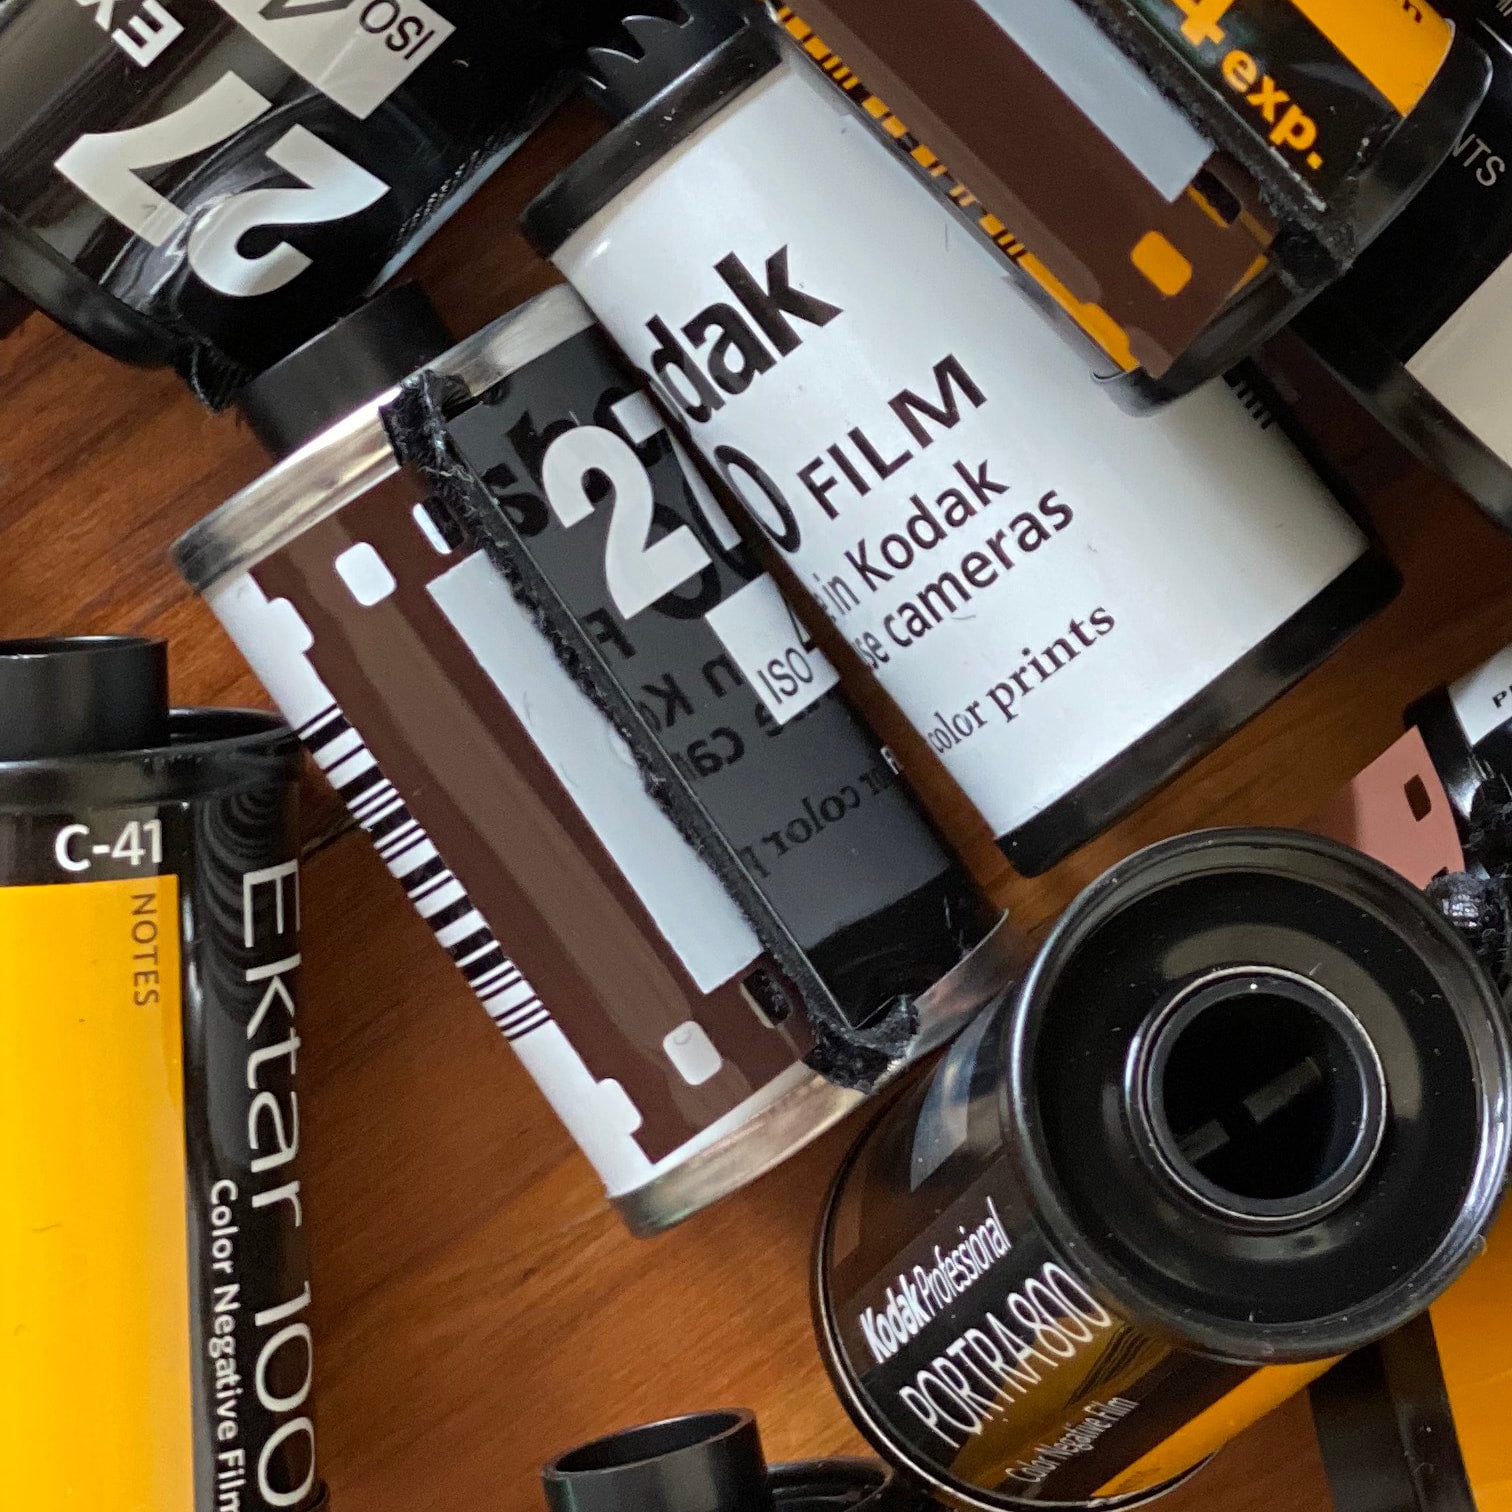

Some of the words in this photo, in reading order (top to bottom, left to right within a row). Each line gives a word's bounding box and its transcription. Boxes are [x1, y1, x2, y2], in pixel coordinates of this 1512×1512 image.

[54, 68, 389, 298] 27
[1221, 49, 1324, 170] exp.
[644, 243, 845, 423] dak
[795, 352, 989, 520] FILM
[845, 454, 1011, 595] Kodak
[889, 485, 1075, 648] cameras
[757, 643, 814, 707] ISO
[929, 695, 989, 756] color
[987, 600, 1117, 722] prints
[55, 819, 163, 872] C-41
[130, 893, 160, 1007] NOTES
[244, 859, 302, 1227] Ektar
[211, 1179, 240, 1274] Color
[859, 1274, 932, 1364] Kodak
[913, 1196, 1011, 1317] Professional
[209, 1284, 244, 1441] Negative
[254, 1281, 315, 1507] 100
[899, 1312, 1058, 1448] PORTRA
[1007, 1262, 1112, 1358] 800
[1005, 1437, 1058, 1483] Color
[1045, 1410, 1112, 1457] Negative
[1084, 1396, 1140, 1428] Film
